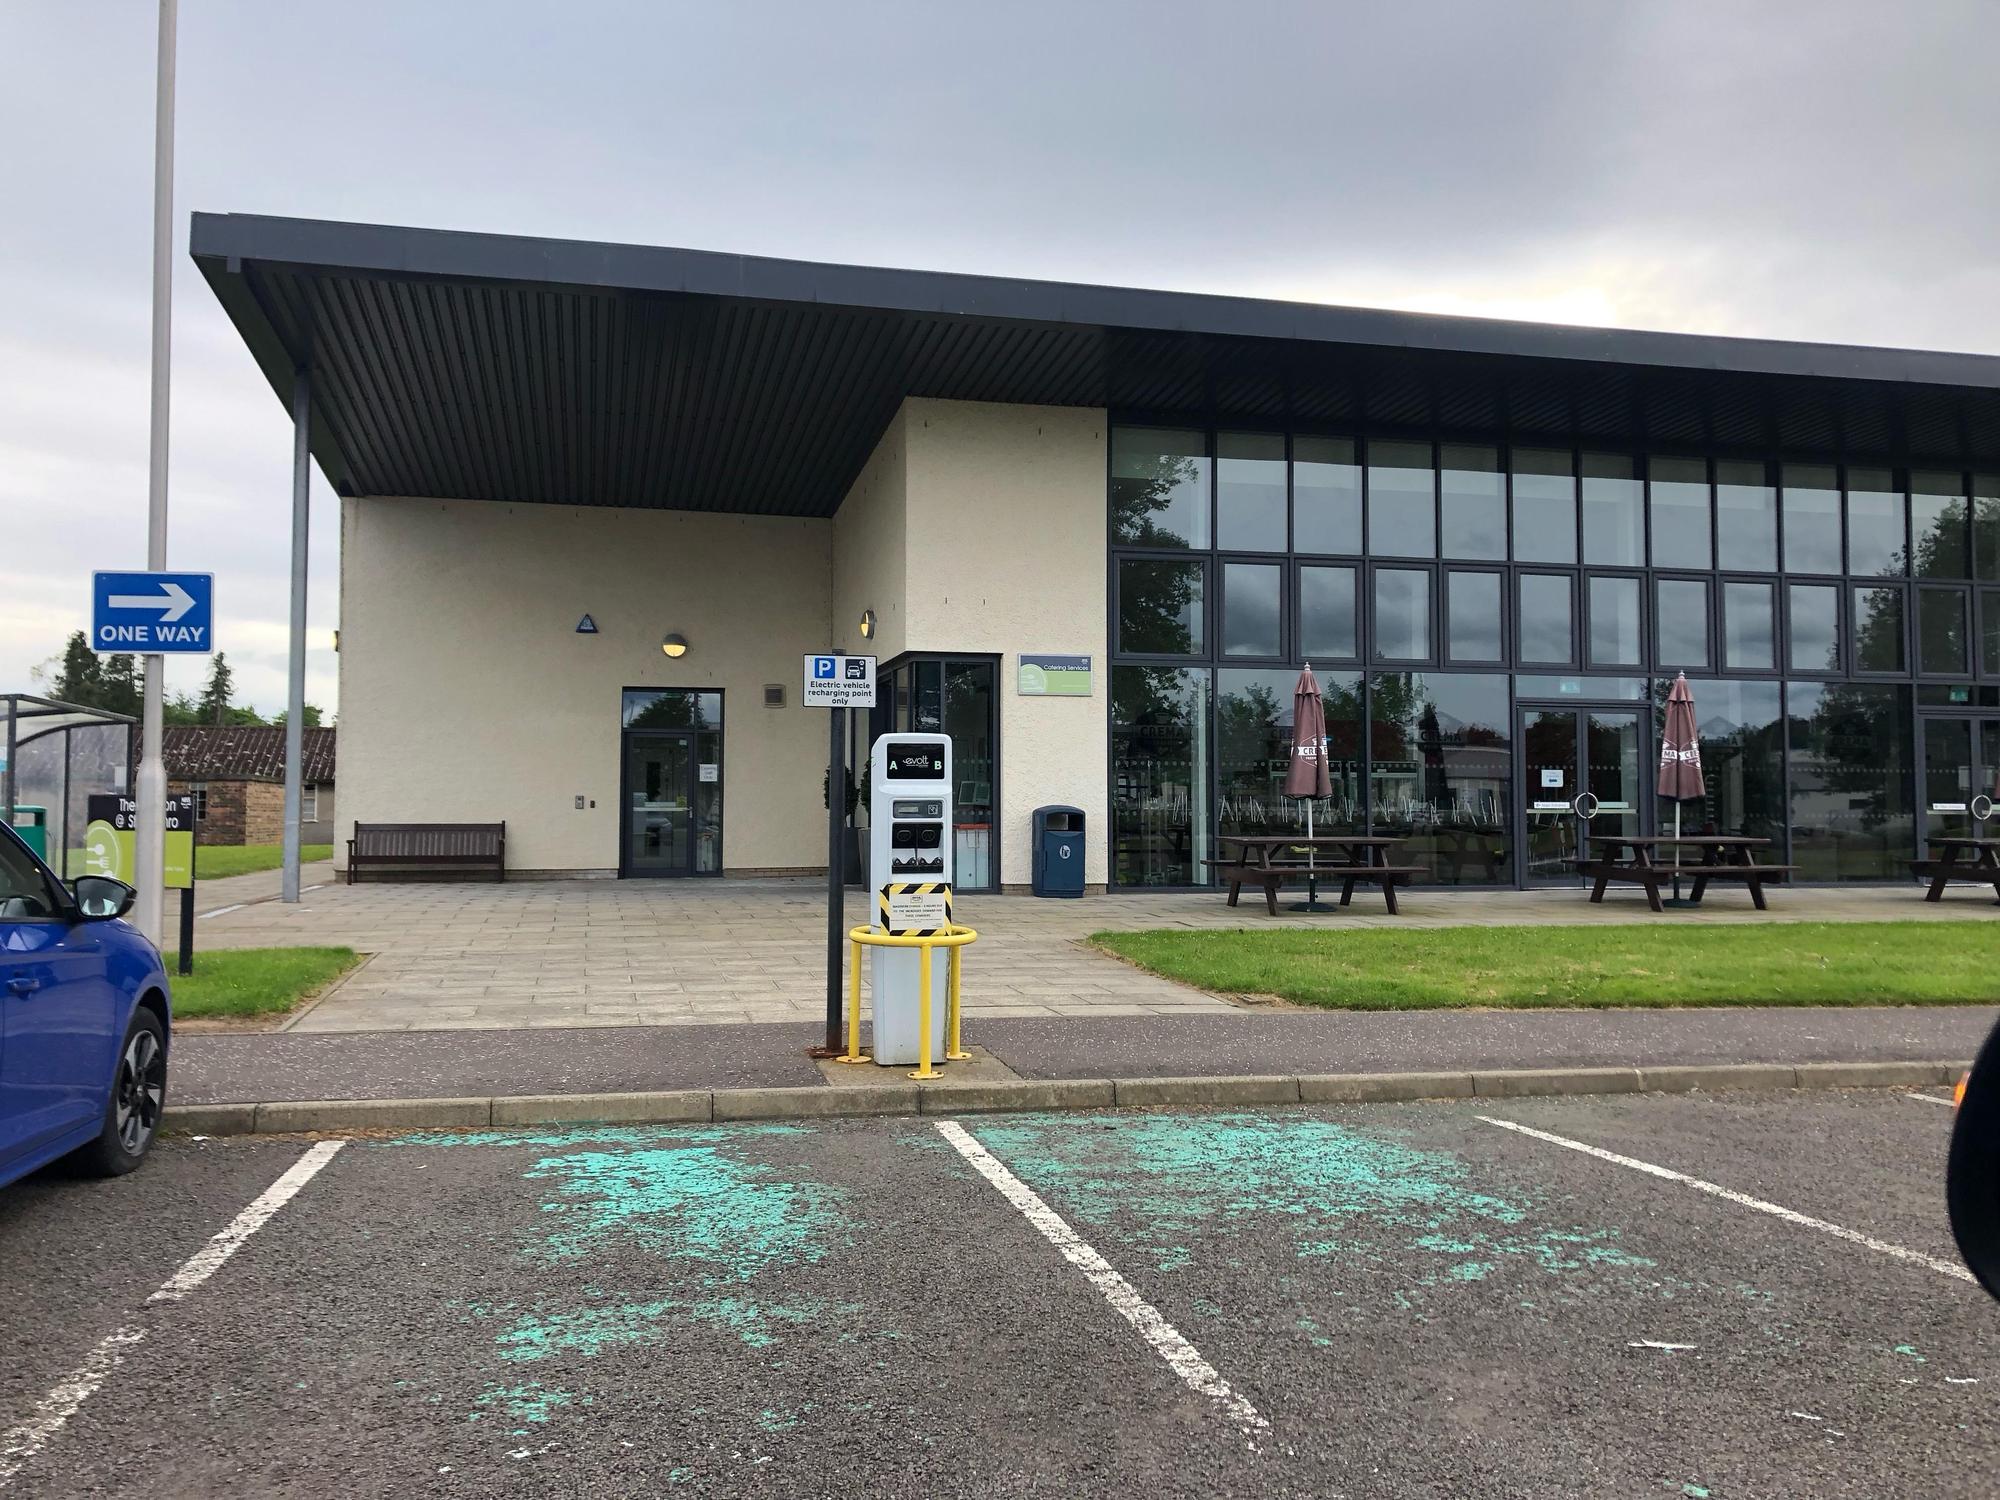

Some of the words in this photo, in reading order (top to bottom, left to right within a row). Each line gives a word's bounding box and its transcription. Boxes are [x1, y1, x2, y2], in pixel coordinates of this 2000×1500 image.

[99, 625, 149, 642] ONE
[155, 626, 205, 642] WAY
[818, 659, 832, 677] P
[810, 680, 841, 689] Electric
[843, 681, 871, 689] vehicle
[808, 689, 850, 697] recharging
[831, 697, 849, 706] only
[1140, 726, 1185, 738] CREMA
[889, 760, 898, 770] A
[902, 754, 929, 765] evolt
[934, 760, 942, 770] B
[119, 797, 134, 812] The
[115, 813, 125, 828] @
